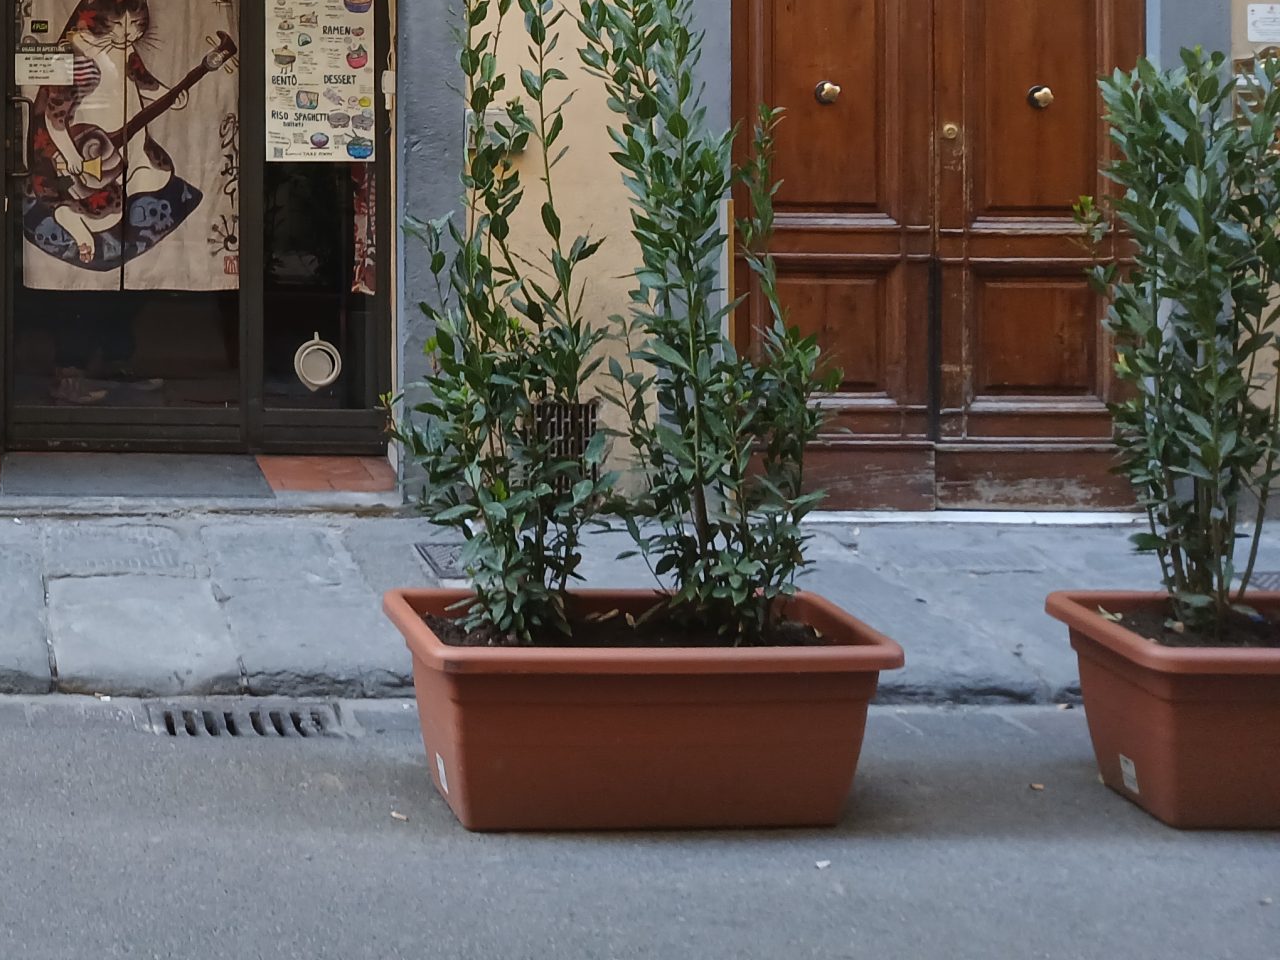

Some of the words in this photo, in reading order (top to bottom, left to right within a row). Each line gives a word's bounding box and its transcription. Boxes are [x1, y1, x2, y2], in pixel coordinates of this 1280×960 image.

[322, 25, 351, 35] RAMEN
[323, 74, 357, 85] DESSERT
[271, 110, 289, 120] RISO
